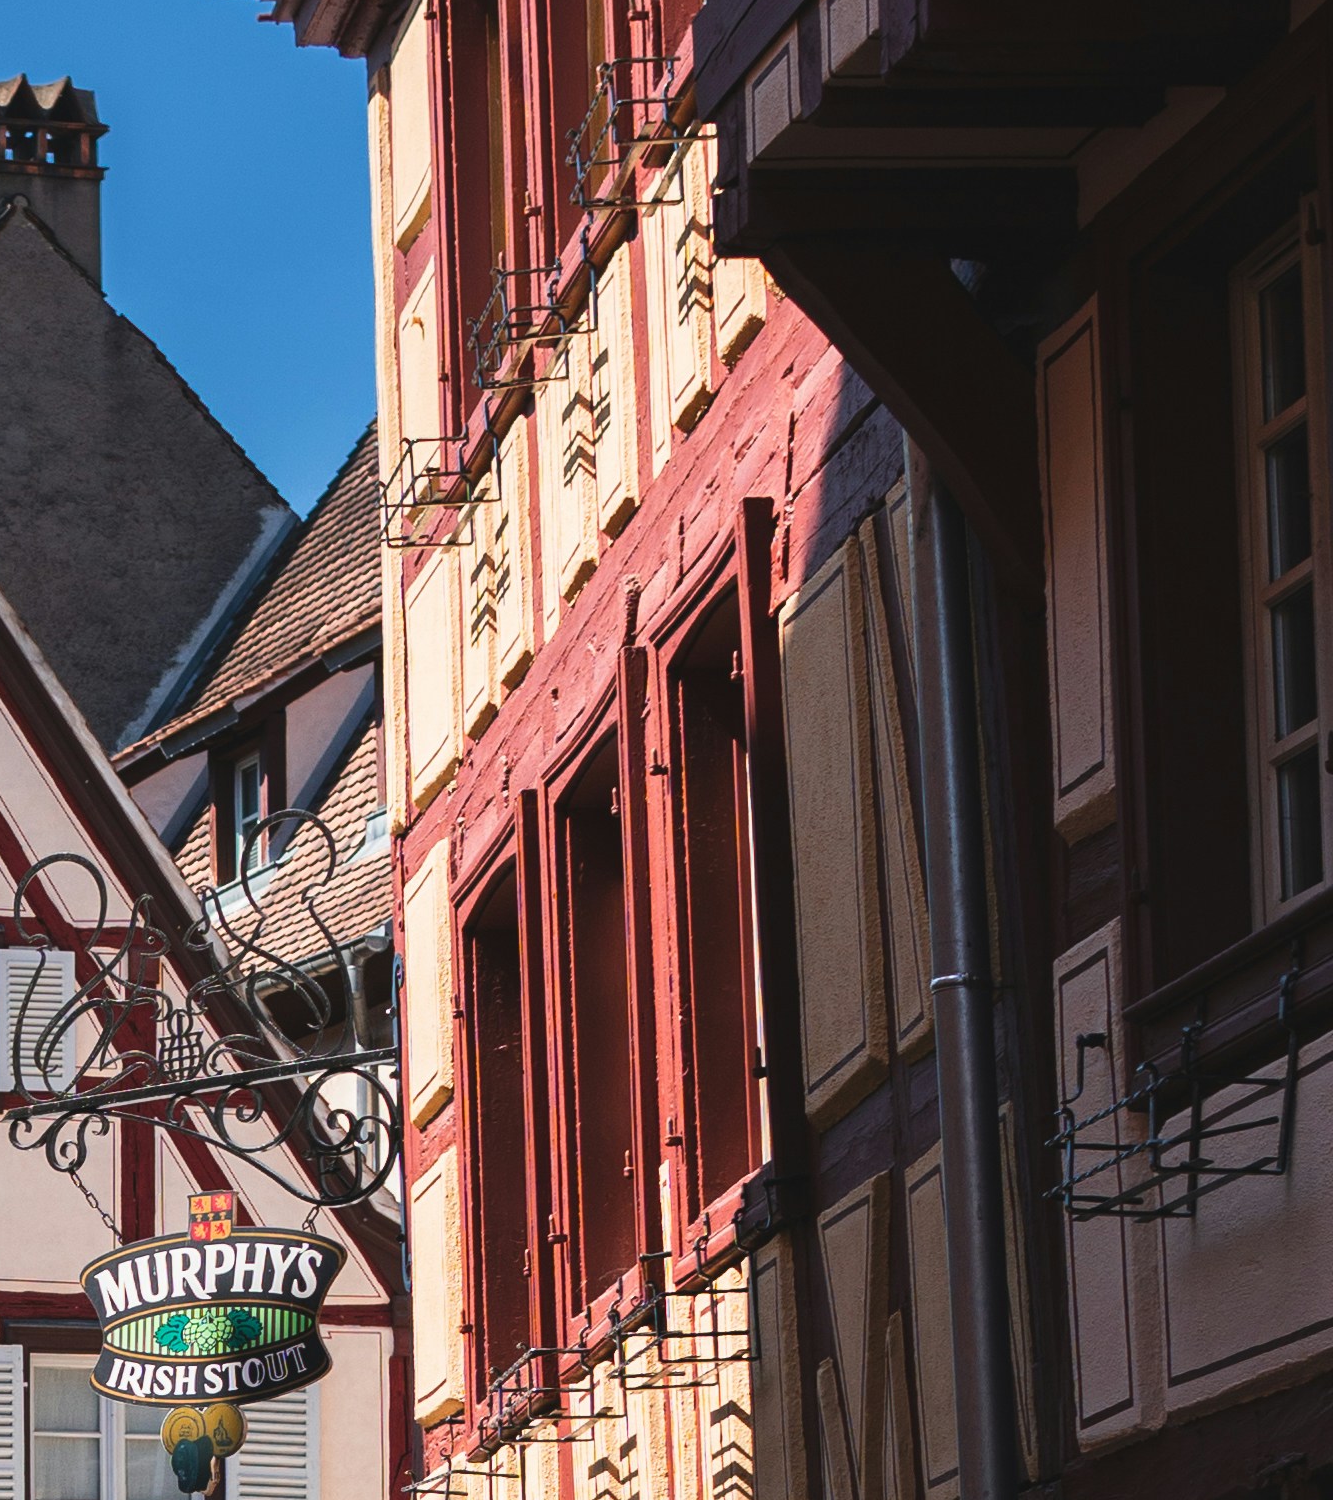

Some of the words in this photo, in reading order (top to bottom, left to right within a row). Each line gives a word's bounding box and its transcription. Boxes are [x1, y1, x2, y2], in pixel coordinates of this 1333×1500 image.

[94, 1242, 323, 1318] MURPHY'S
[105, 1358, 199, 1398] IRISH
[203, 1343, 306, 1395] STOUT
